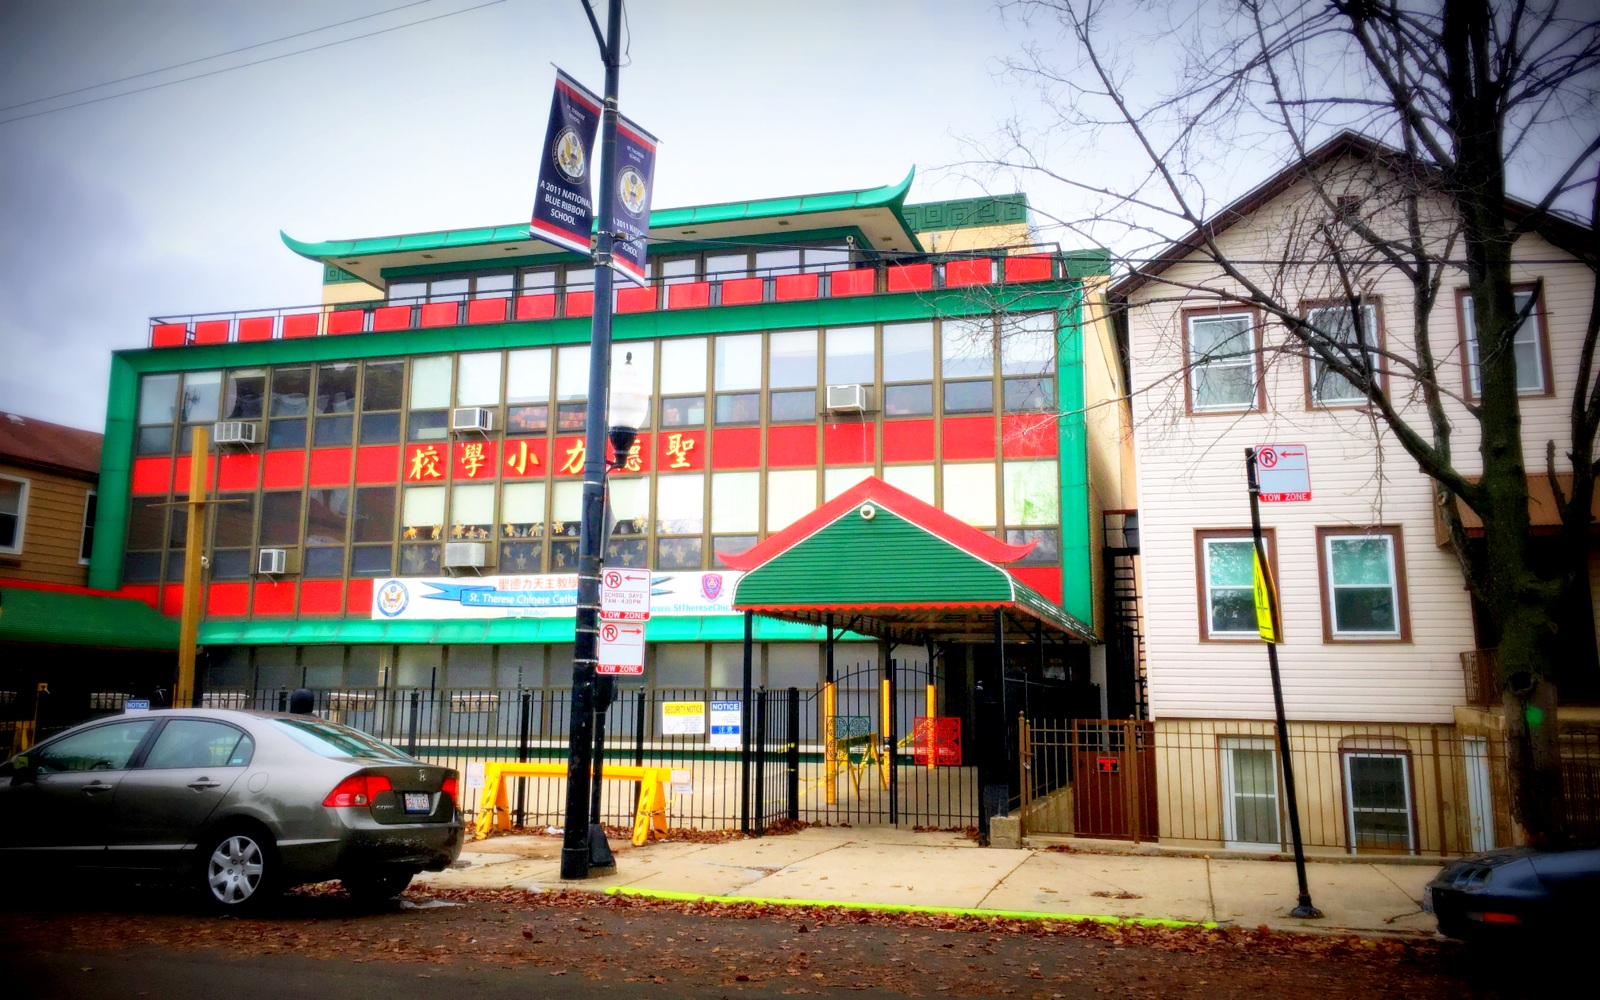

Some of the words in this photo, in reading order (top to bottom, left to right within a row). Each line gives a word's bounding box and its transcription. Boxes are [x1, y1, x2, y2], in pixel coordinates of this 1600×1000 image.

[540, 180, 546, 189] A
[545, 182, 562, 196] 2011
[562, 189, 592, 210] NATIONAL
[544, 193, 561, 207] BLUE
[561, 200, 586, 217] RIBBON
[550, 208, 576, 226] SCHOOL
[622, 241, 638, 258] SCHOOL
[1263, 493, 1281, 502] TOW
[1284, 493, 1307, 501] ZONE
[469, 592, 480, 602] St.
[482, 593, 515, 604] Therese
[517, 594, 551, 604] Chinese
[552, 593, 578, 604] Catho
[523, 608, 549, 616] Ribbon
[650, 603, 733, 612] www.StThereseChic
[624, 612, 646, 620] ZONE
[600, 665, 616, 673] TOW
[619, 665, 639, 673] ZONE
[664, 705, 686, 714] SECURITY
[686, 704, 703, 714] NOTICE
